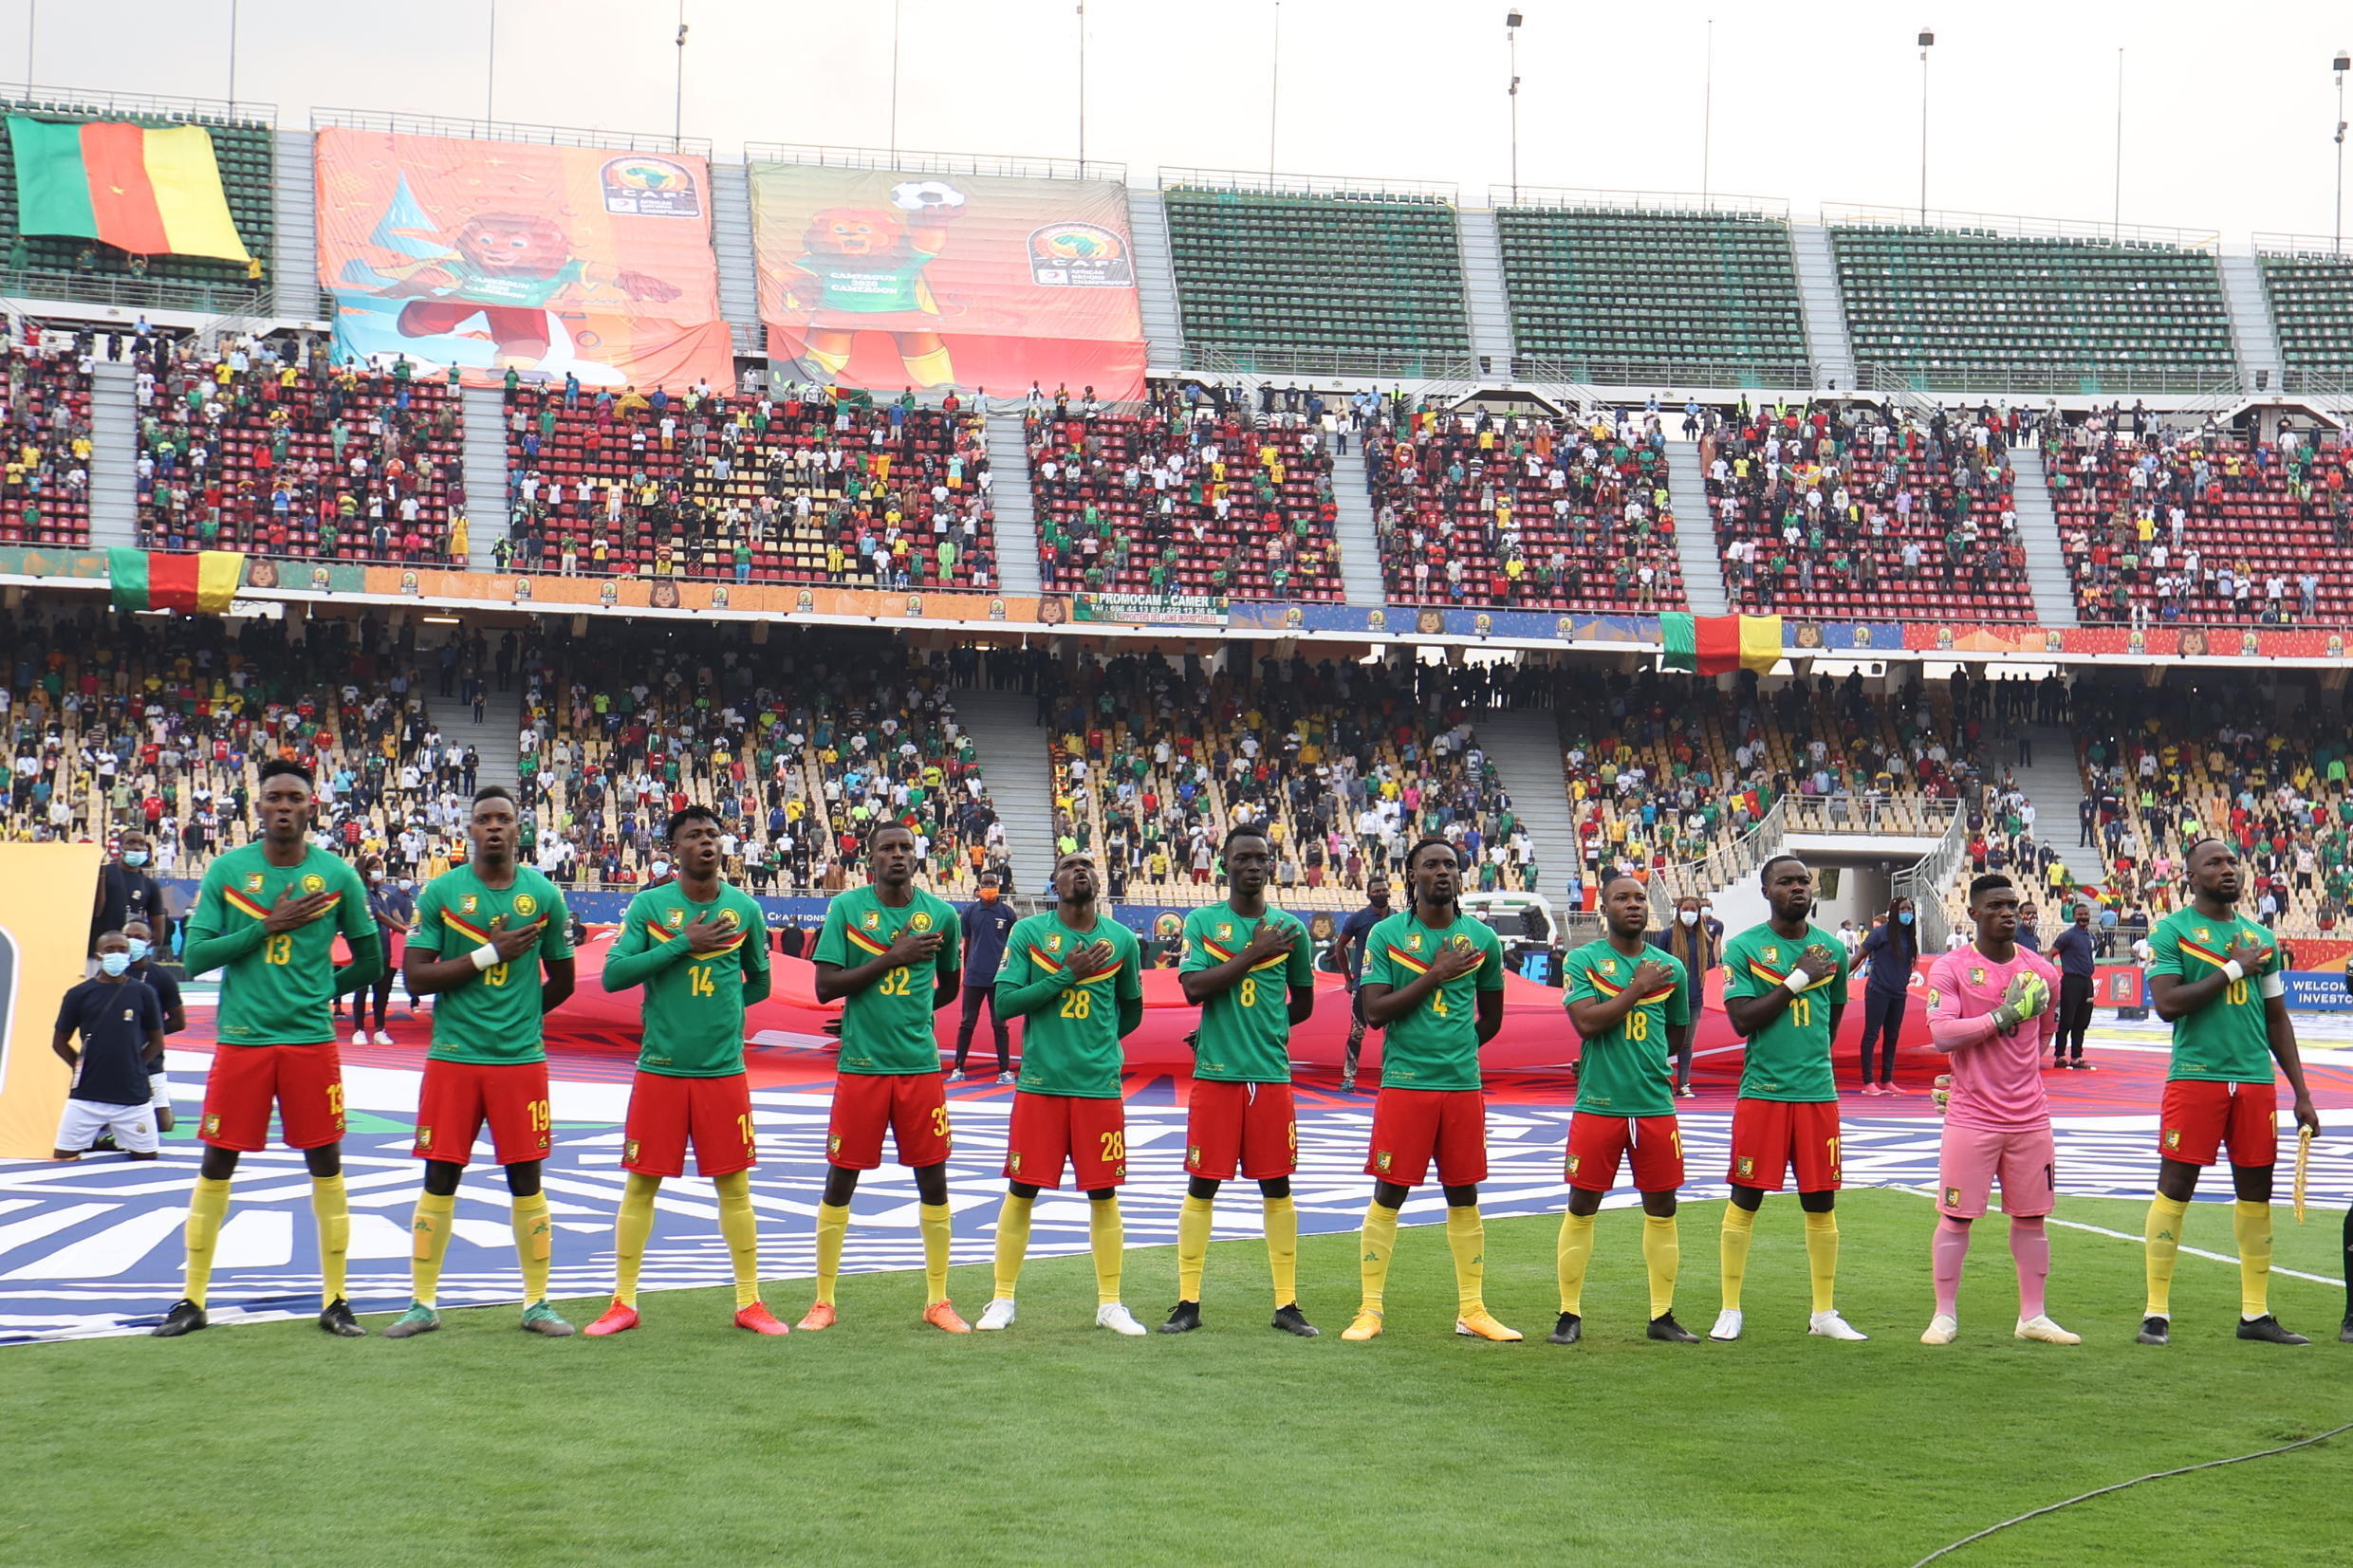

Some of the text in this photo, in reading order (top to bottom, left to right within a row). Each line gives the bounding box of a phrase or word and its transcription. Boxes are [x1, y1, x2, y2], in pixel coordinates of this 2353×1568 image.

[622, 189, 677, 198] CAF
[830, 272, 897, 282] CAMEROUN
[831, 284, 898, 294] CAMEROON
[1099, 593, 1161, 606] PROMOCAM
[1170, 595, 1209, 607] CAMER
[265, 934, 292, 966] 13
[688, 966, 714, 997] 14
[880, 967, 911, 995] 32
[1241, 978, 1255, 1007] 8
[2226, 978, 2247, 1005] 10
[2292, 980, 2348, 991] WELCOM
[1061, 988, 1090, 1019] 28
[1434, 988, 1448, 1017] 4
[1789, 998, 1809, 1026] 11
[1624, 1010, 1647, 1042] 18
[528, 1099, 549, 1132] 19
[1101, 1131, 1124, 1162] 28
[1288, 1121, 1296, 1151] 8
